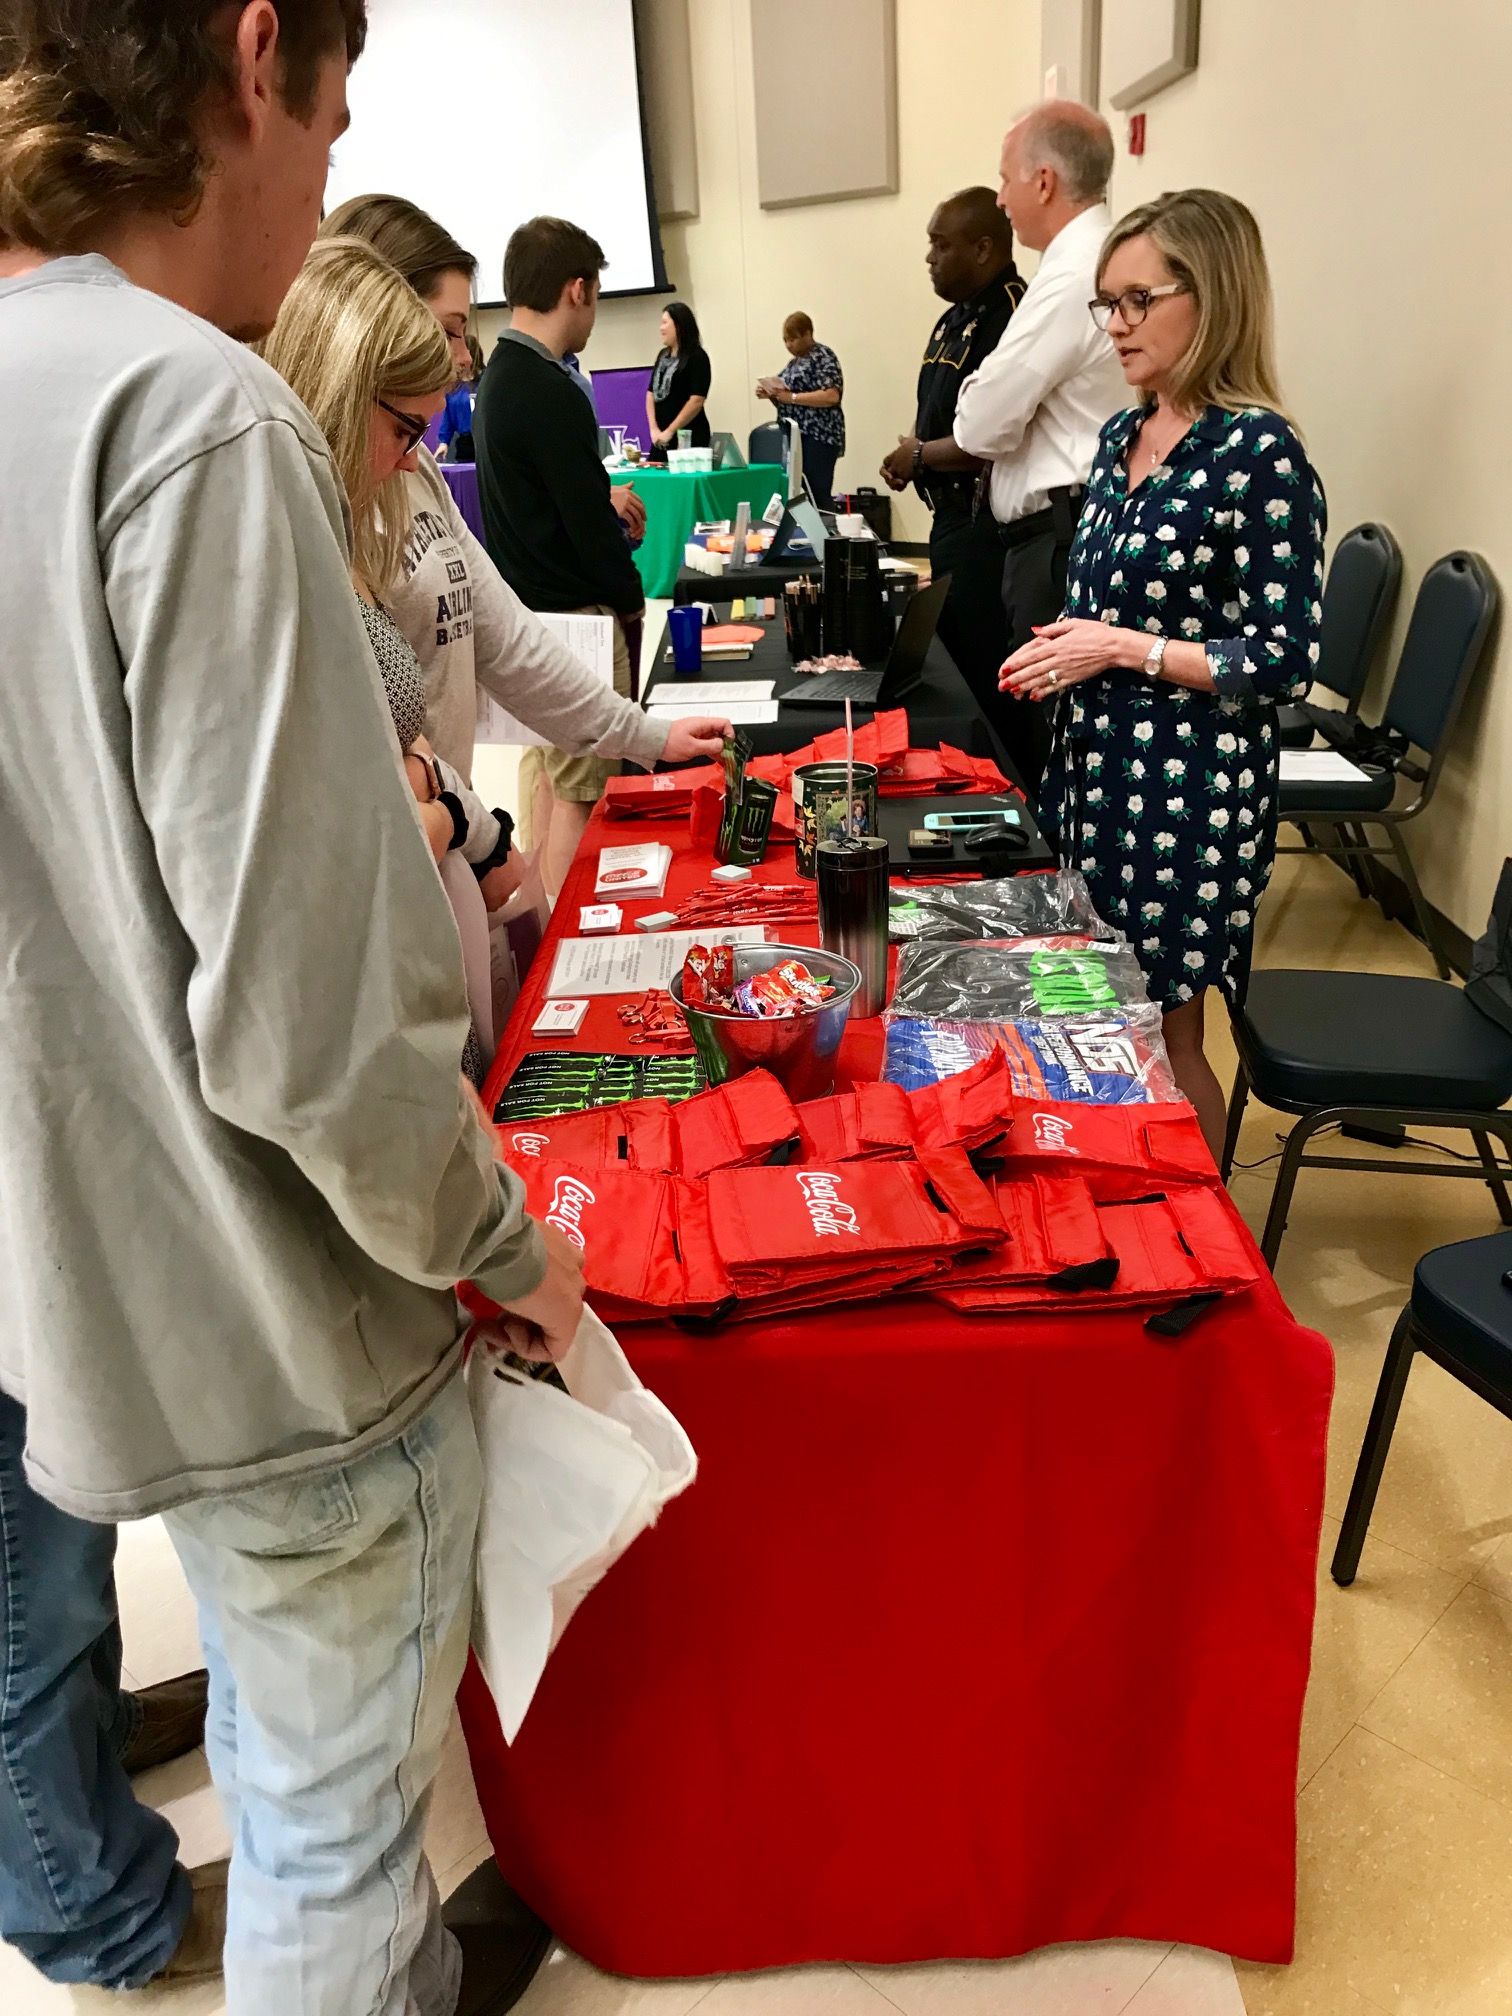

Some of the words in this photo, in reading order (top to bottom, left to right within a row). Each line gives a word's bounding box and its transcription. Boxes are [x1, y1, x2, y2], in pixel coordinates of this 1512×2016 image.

[447, 562, 465, 580] XXL
[545, 1175, 596, 1252] Coca-C
[796, 1171, 861, 1237] Coca-Cola
